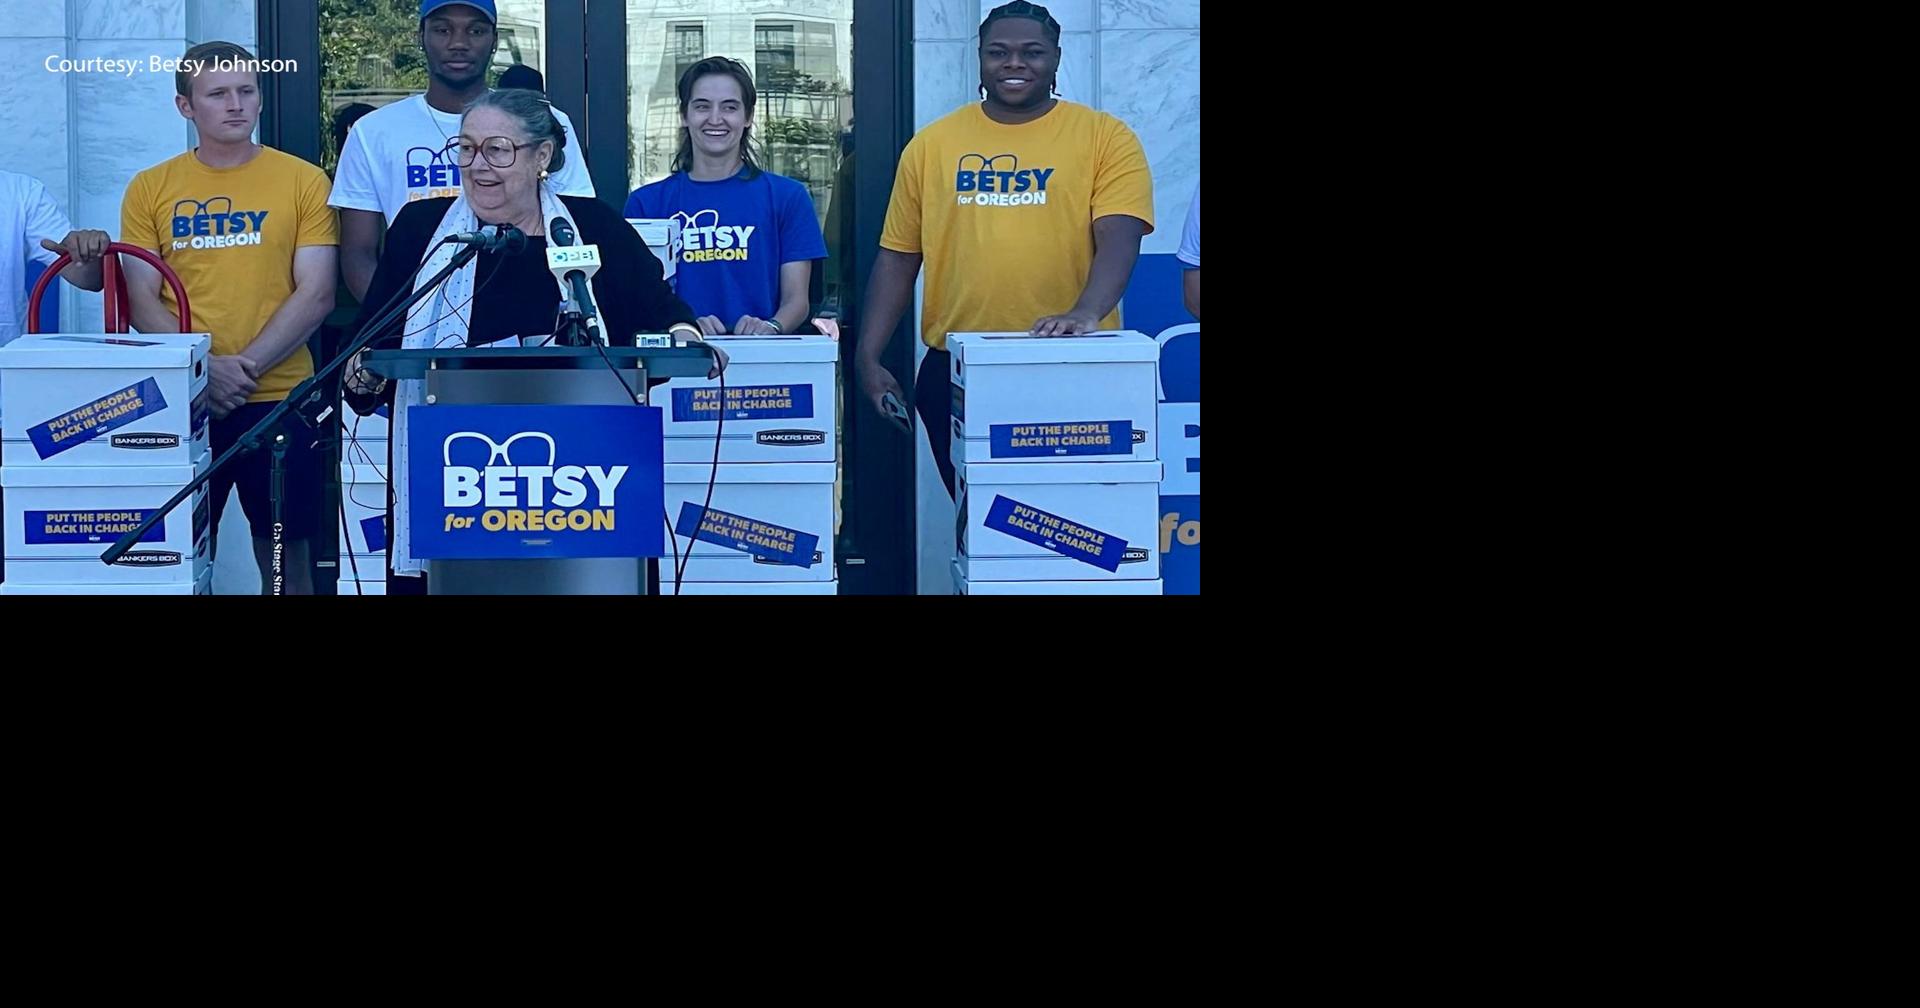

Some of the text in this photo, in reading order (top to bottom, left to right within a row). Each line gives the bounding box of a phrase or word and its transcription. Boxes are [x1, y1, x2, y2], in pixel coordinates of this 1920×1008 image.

[956, 168, 1055, 193] BETSY
[957, 191, 1046, 206] for OREGON
[172, 211, 269, 238] BETSY
[172, 232, 261, 251] for OREGON
[683, 248, 748, 263] OREGON
[694, 390, 717, 400] PUT
[744, 388, 790, 398] PEOPLE
[727, 401, 741, 410] IN
[742, 399, 792, 410] CHARGE
[48, 389, 137, 432] PUT THE PEOPLE
[52, 398, 144, 443] BACK IN CHARGE
[1011, 435, 1111, 447] BACK IN CHARGE
[1013, 424, 1109, 436] PUT THE PEOPLE
[443, 465, 629, 508] BETSY
[45, 523, 141, 534] BACK IN CHARG
[46, 512, 142, 523] PUT THE PEOPLE
[444, 509, 615, 532] for OREGON
[728, 516, 750, 530] THE
[751, 523, 796, 542] PEOPLE
[1013, 505, 1039, 521] PUT
[1038, 513, 1061, 529] THE
[1061, 523, 1105, 545] PEOPLE
[731, 529, 744, 540] IN
[746, 534, 794, 553] CHARGE
[1008, 515, 1040, 533] BACK
[1040, 527, 1054, 538] IN
[1055, 533, 1102, 556] CHARGE
